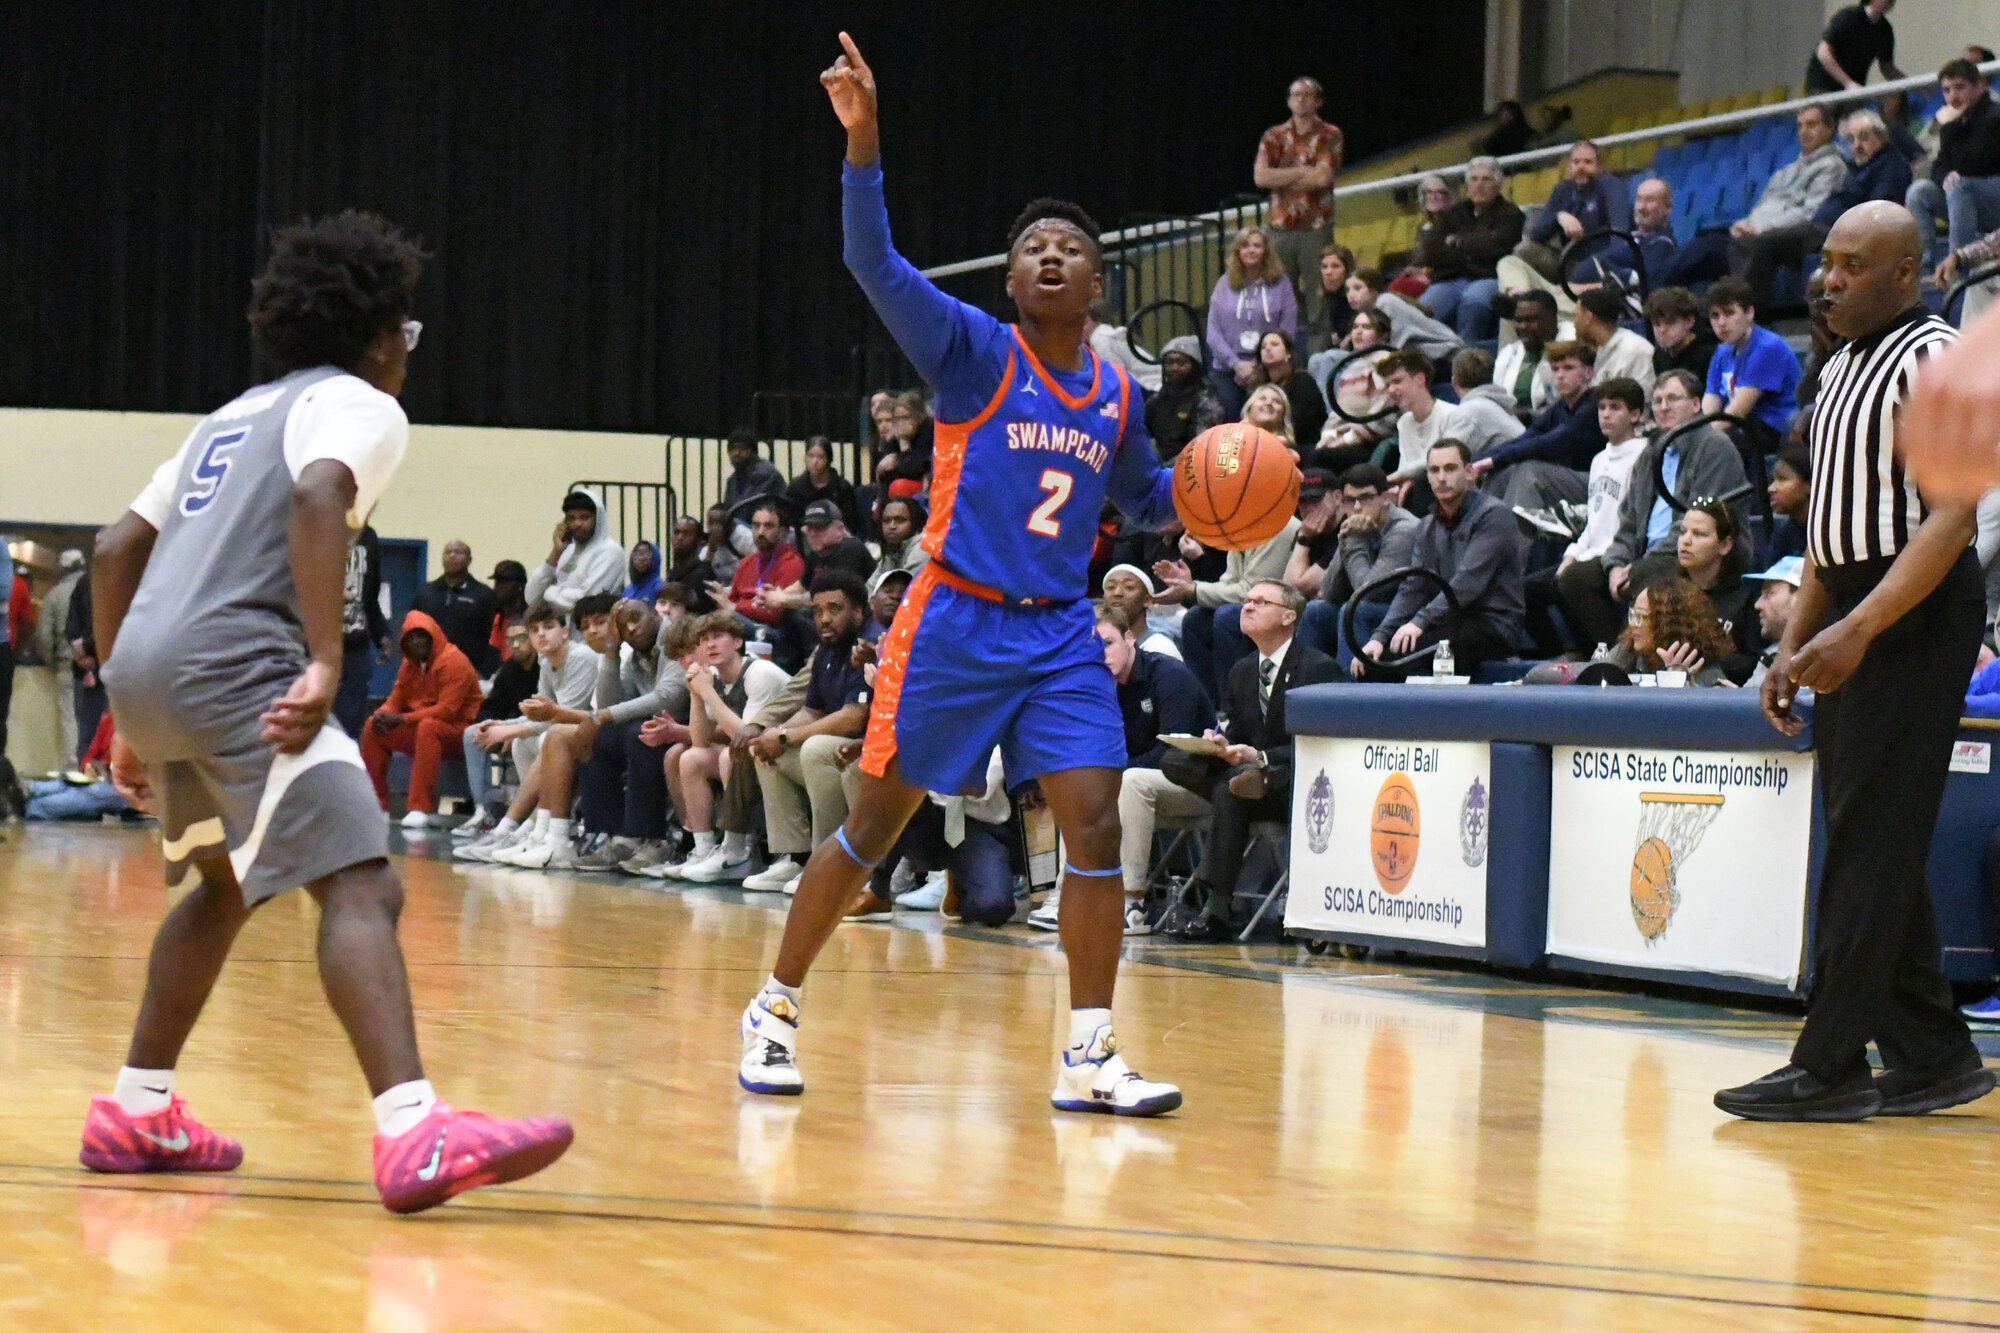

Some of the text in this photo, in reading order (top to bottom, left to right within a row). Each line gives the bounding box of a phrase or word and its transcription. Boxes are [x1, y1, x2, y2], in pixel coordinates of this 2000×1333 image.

[179, 425, 253, 518] 5
[1026, 468, 1074, 538] 2
[1364, 745, 1439, 773] Official Ball
[1572, 751, 1788, 795] SCISA State Championship
[1377, 802, 1415, 828] SPALDING
[1324, 886, 1462, 929] SCISA Championship
